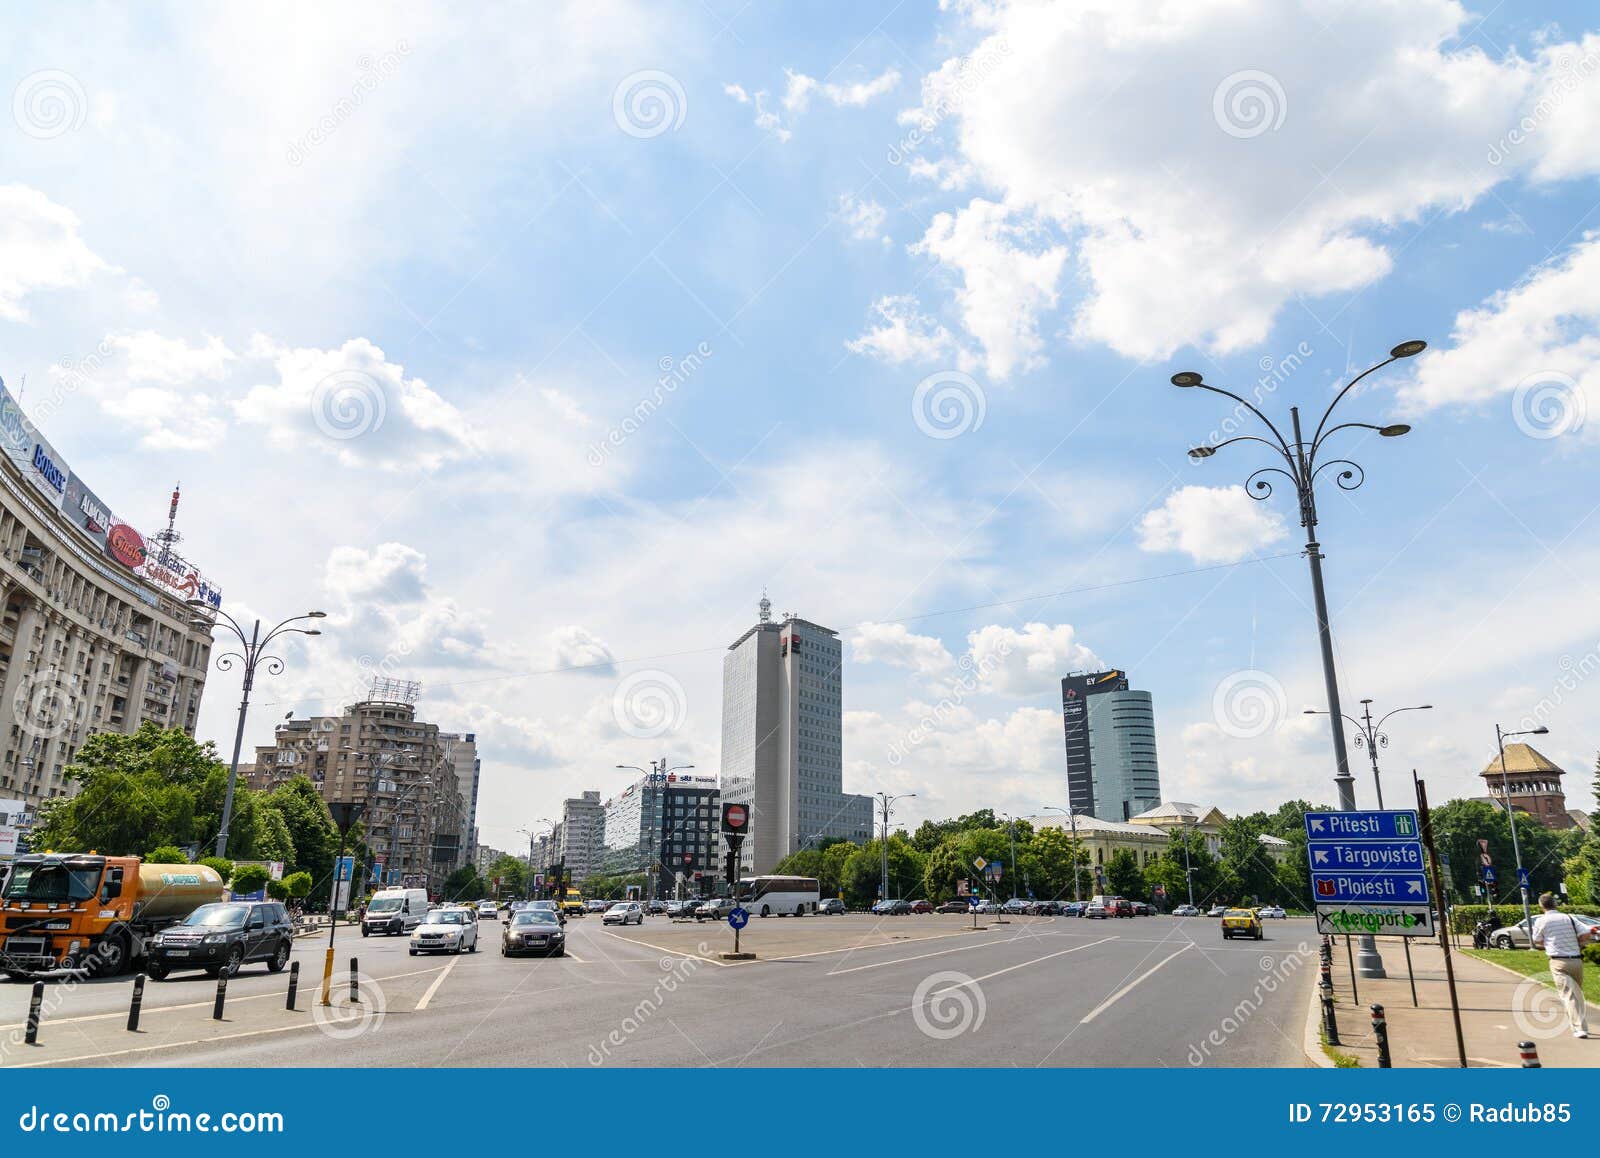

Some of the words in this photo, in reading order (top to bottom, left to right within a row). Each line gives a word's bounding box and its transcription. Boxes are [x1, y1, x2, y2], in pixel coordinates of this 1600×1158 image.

[33, 443, 66, 493] BORSEC
[158, 548, 187, 577] URGENT
[1086, 677, 1096, 686] EY
[1330, 816, 1380, 835] Pitești
[1334, 846, 1418, 867] Târgoviște
[1338, 877, 1395, 898] Ploiești
[1341, 908, 1408, 930] Aeroport
